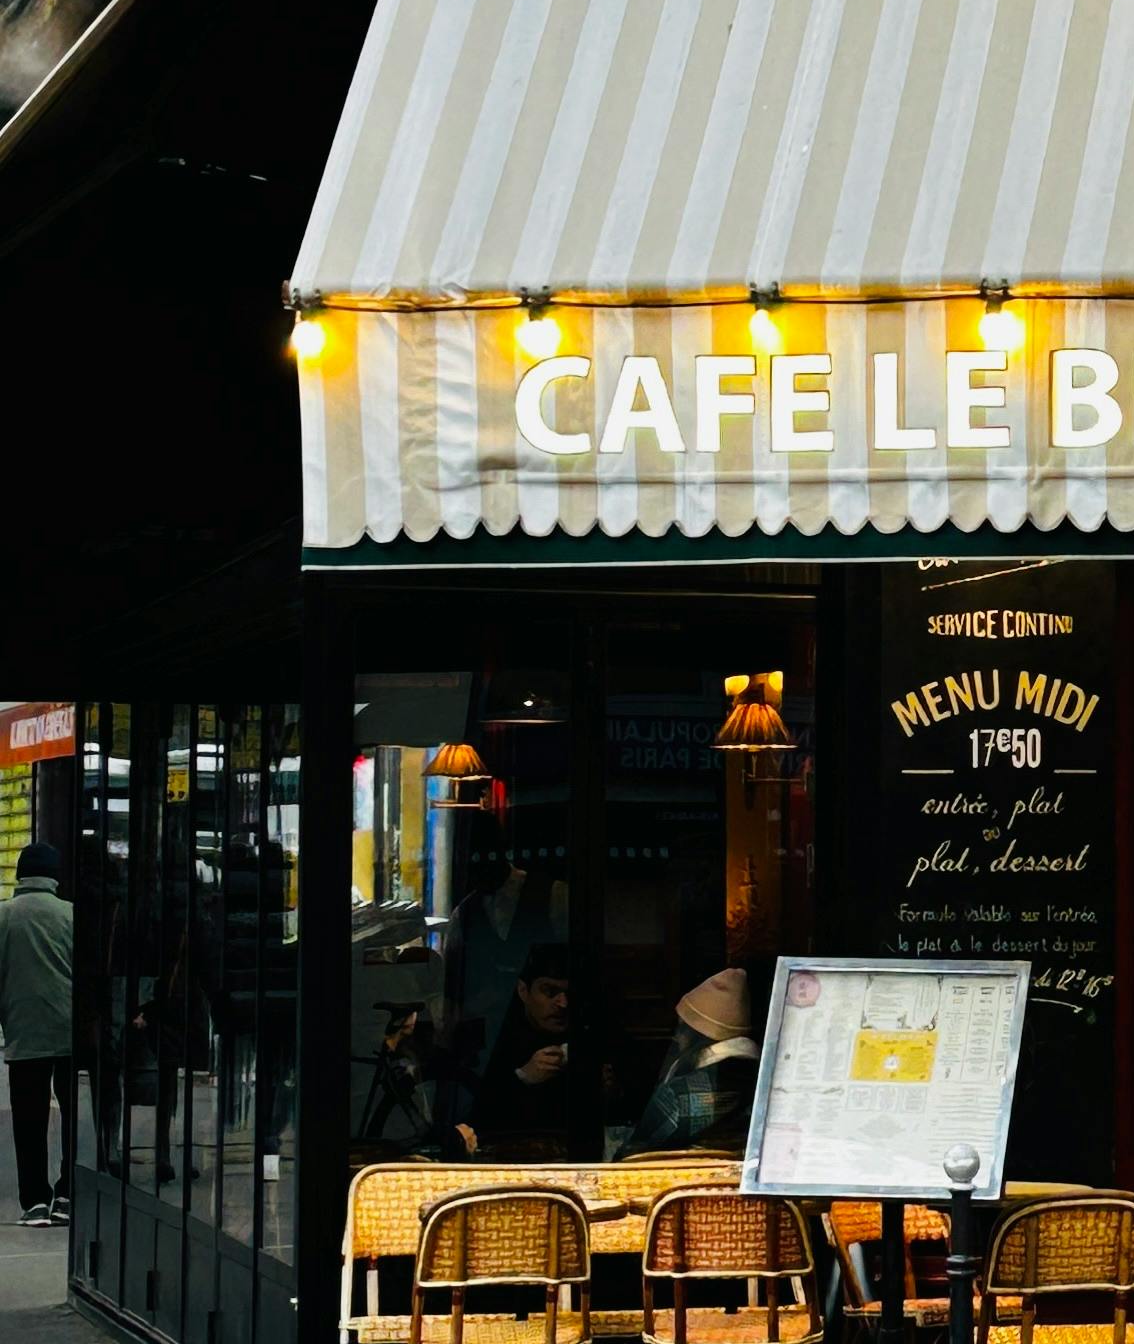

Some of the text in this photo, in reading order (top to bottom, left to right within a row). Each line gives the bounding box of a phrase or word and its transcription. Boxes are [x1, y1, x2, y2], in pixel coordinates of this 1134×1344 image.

[514, 353, 834, 456] CAFE
[872, 350, 1011, 452] LE
[927, 609, 1074, 639] SERVICE CONTINU
[891, 668, 1100, 738] MENU MIDI
[1006, 785, 1065, 830] plat
[989, 838, 1091, 873] dessert
[965, 904, 1012, 923] valable
[916, 937, 942, 957] plat
[992, 935, 1048, 953] dessert
